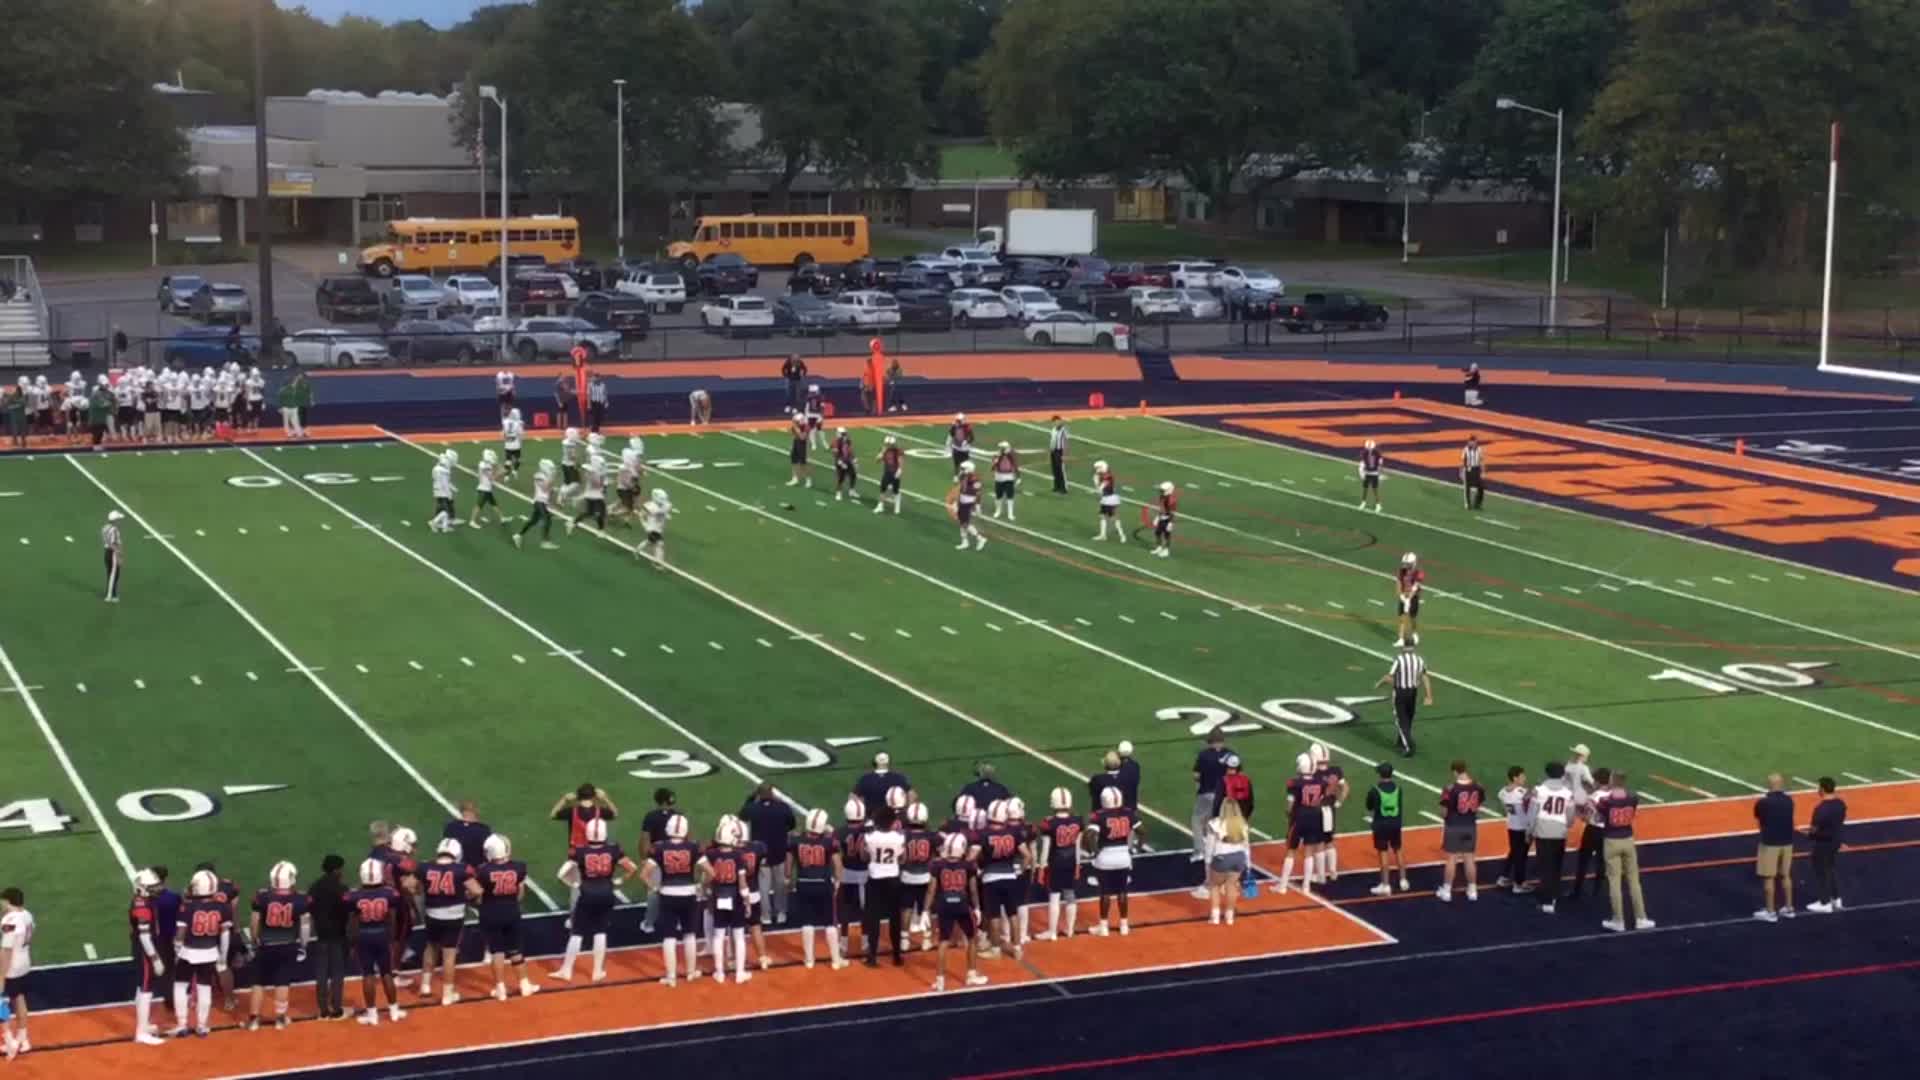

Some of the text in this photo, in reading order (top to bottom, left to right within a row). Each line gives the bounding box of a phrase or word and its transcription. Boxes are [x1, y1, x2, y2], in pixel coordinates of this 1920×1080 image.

[1543, 796, 1566, 815] 40
[875, 847, 895, 864] 12
[426, 868, 456, 896] 74
